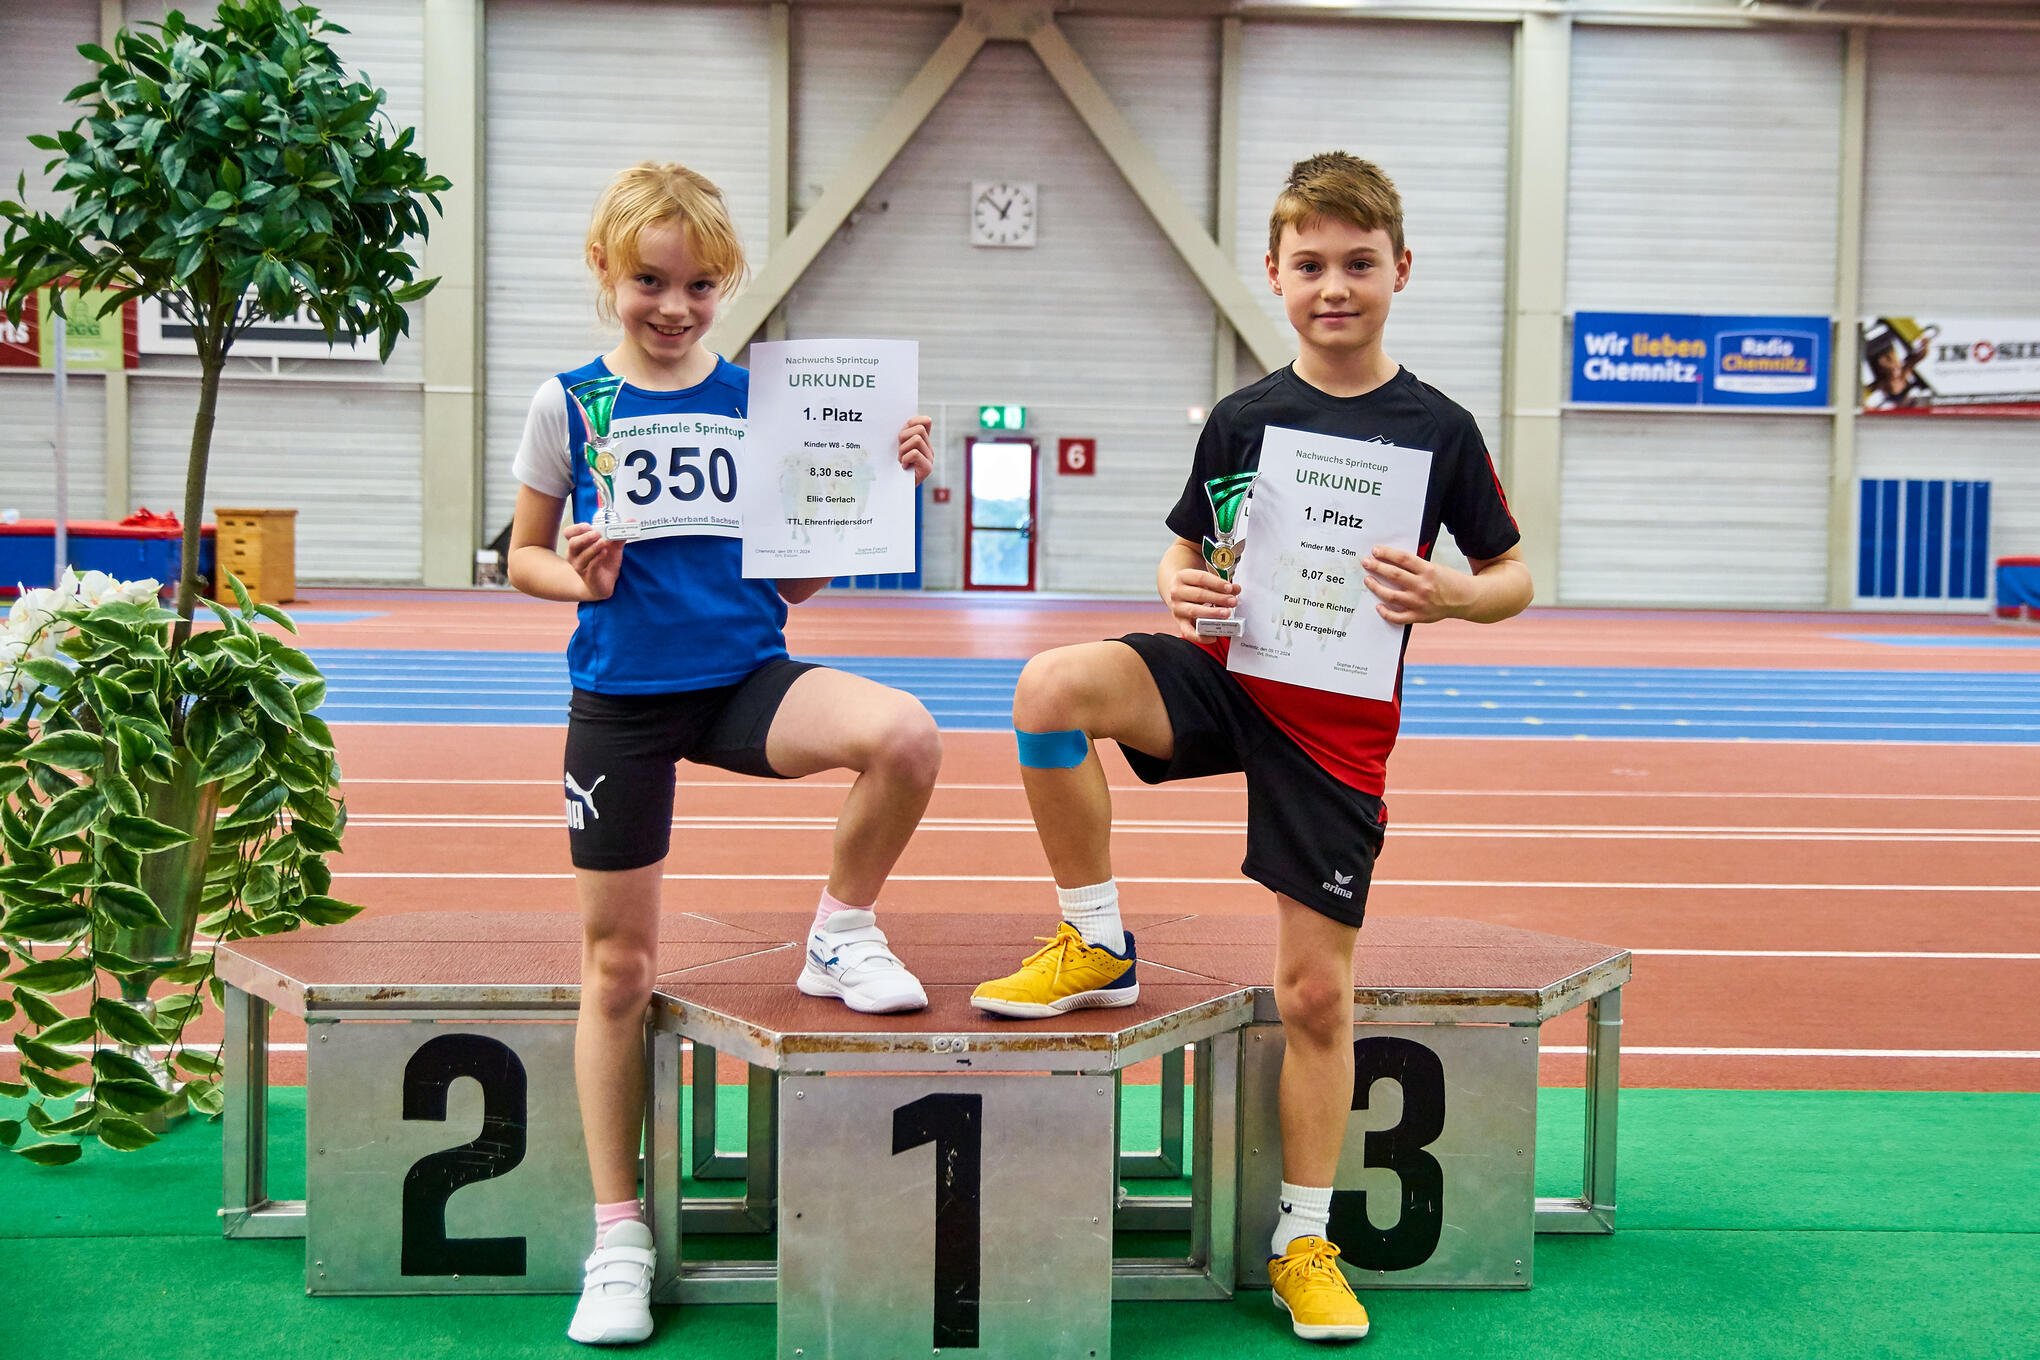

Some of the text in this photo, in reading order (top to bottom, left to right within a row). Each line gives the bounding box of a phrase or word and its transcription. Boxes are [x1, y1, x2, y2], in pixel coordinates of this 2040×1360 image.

[1583, 331, 1707, 358] Wir lieben
[1741, 337, 1794, 357] Radio
[785, 356, 880, 366] Nachwuchs Sprintcup
[788, 373, 876, 389] URKUNDE
[802, 407, 863, 422] 1. Platz
[612, 422, 745, 440] andesfinale Sprintcup
[804, 440, 828, 448] Kinder
[828, 441, 840, 449] W8
[1066, 443, 1086, 470] 6
[1295, 449, 1389, 473] Nachwuchs Sprintcup
[624, 446, 738, 505] 350
[809, 467, 853, 478] 8,30 sec
[1296, 469, 1383, 497] URKUNDE
[806, 495, 856, 504] Ellie Gerlach
[640, 515, 740, 527] thletik-Verband Sachsen
[787, 517, 873, 527] TTL Ehrenfriedersdorf
[1304, 506, 1364, 530] 1. Platz
[1300, 540, 1324, 551] Kinder
[1324, 544, 1336, 553] M8
[1341, 548, 1357, 557] 50m
[1301, 568, 1346, 585] 8,07 sec
[1283, 594, 1355, 615] Paul Thore Richter
[1282, 618, 1347, 638] LV 90 Erzgebirge
[1322, 881, 1353, 899] erima
[401, 1033, 528, 1277] 2
[1325, 1036, 1446, 1272] 3
[891, 1092, 983, 1349] 1
